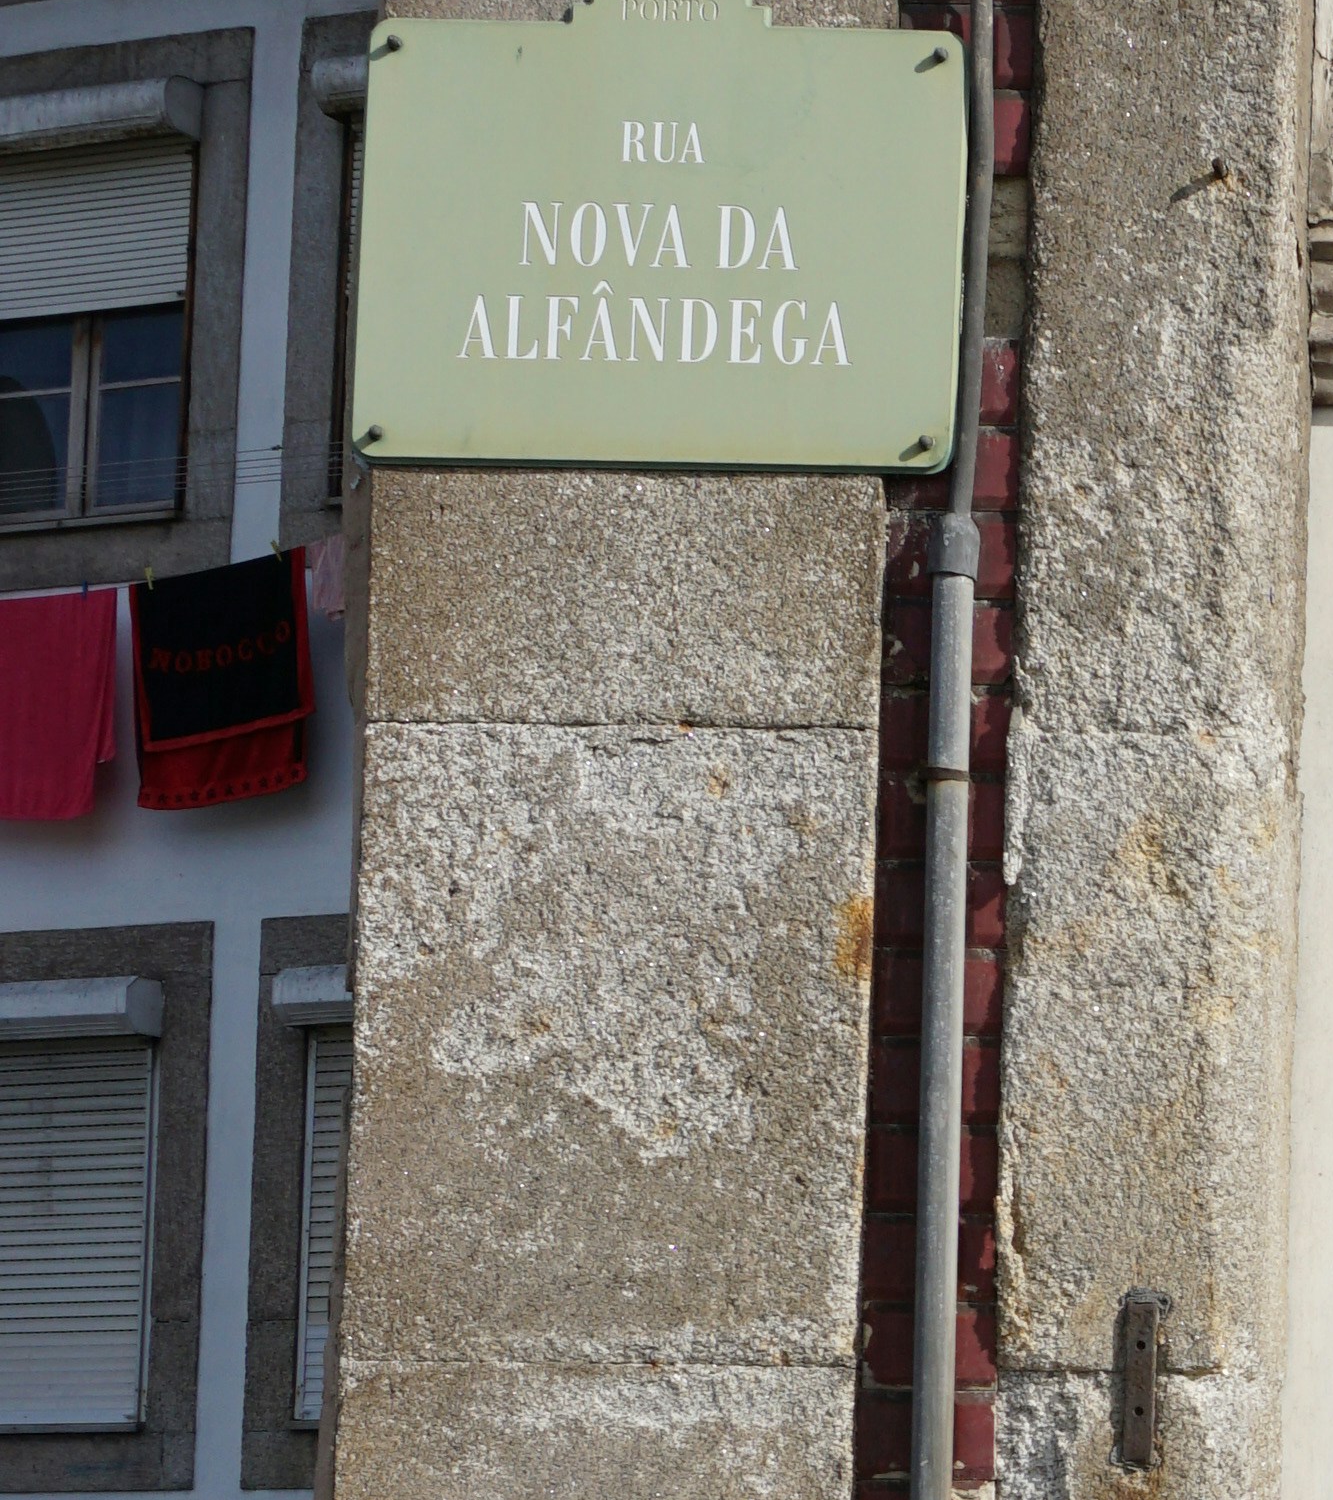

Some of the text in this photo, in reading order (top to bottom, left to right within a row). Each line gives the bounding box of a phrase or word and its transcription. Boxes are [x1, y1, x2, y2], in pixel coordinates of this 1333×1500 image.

[620, 120, 706, 164] RUA
[518, 200, 800, 271] NOVA DA
[455, 279, 853, 366] ALFÂNDEGA
